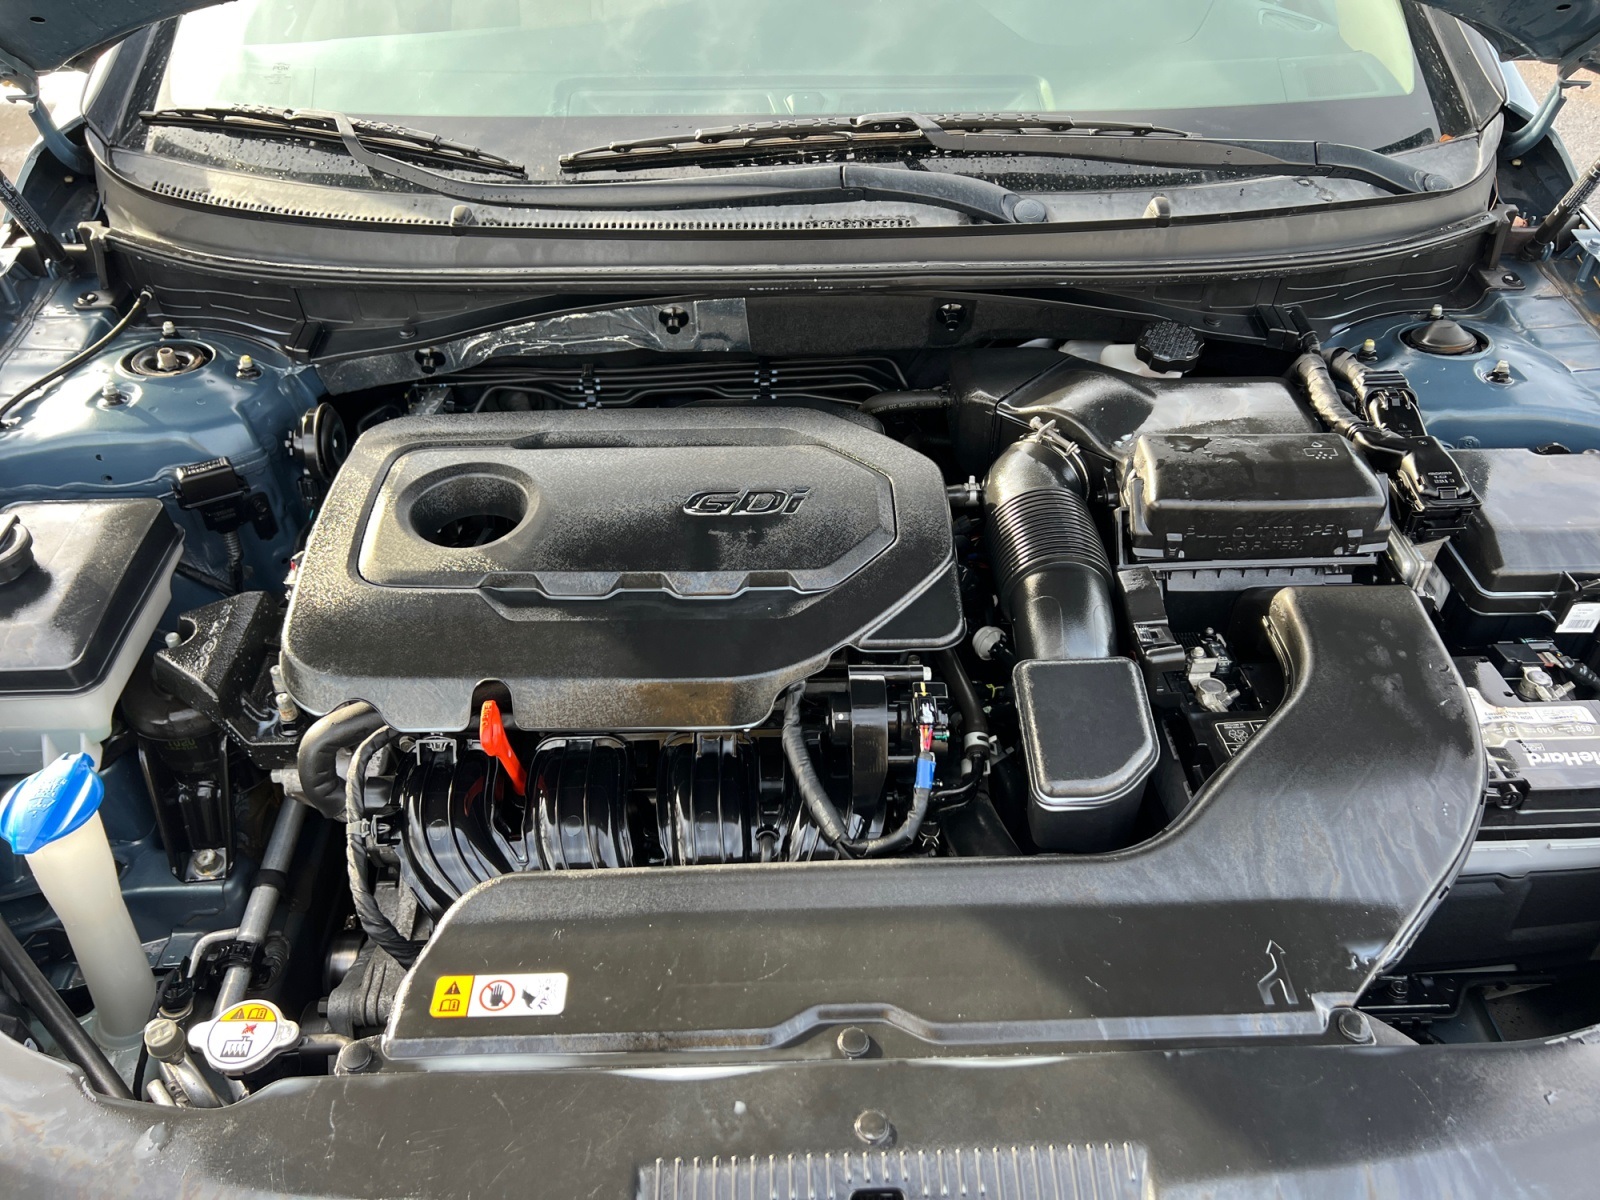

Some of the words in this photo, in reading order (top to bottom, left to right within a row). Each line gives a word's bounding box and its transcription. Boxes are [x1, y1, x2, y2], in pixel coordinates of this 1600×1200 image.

[683, 487, 812, 516] GDi
[1183, 525, 1227, 538] PULL
[1232, 526, 1269, 537] OUT
[1301, 523, 1343, 537] OPEN
[1526, 751, 1600, 766] ieHard
